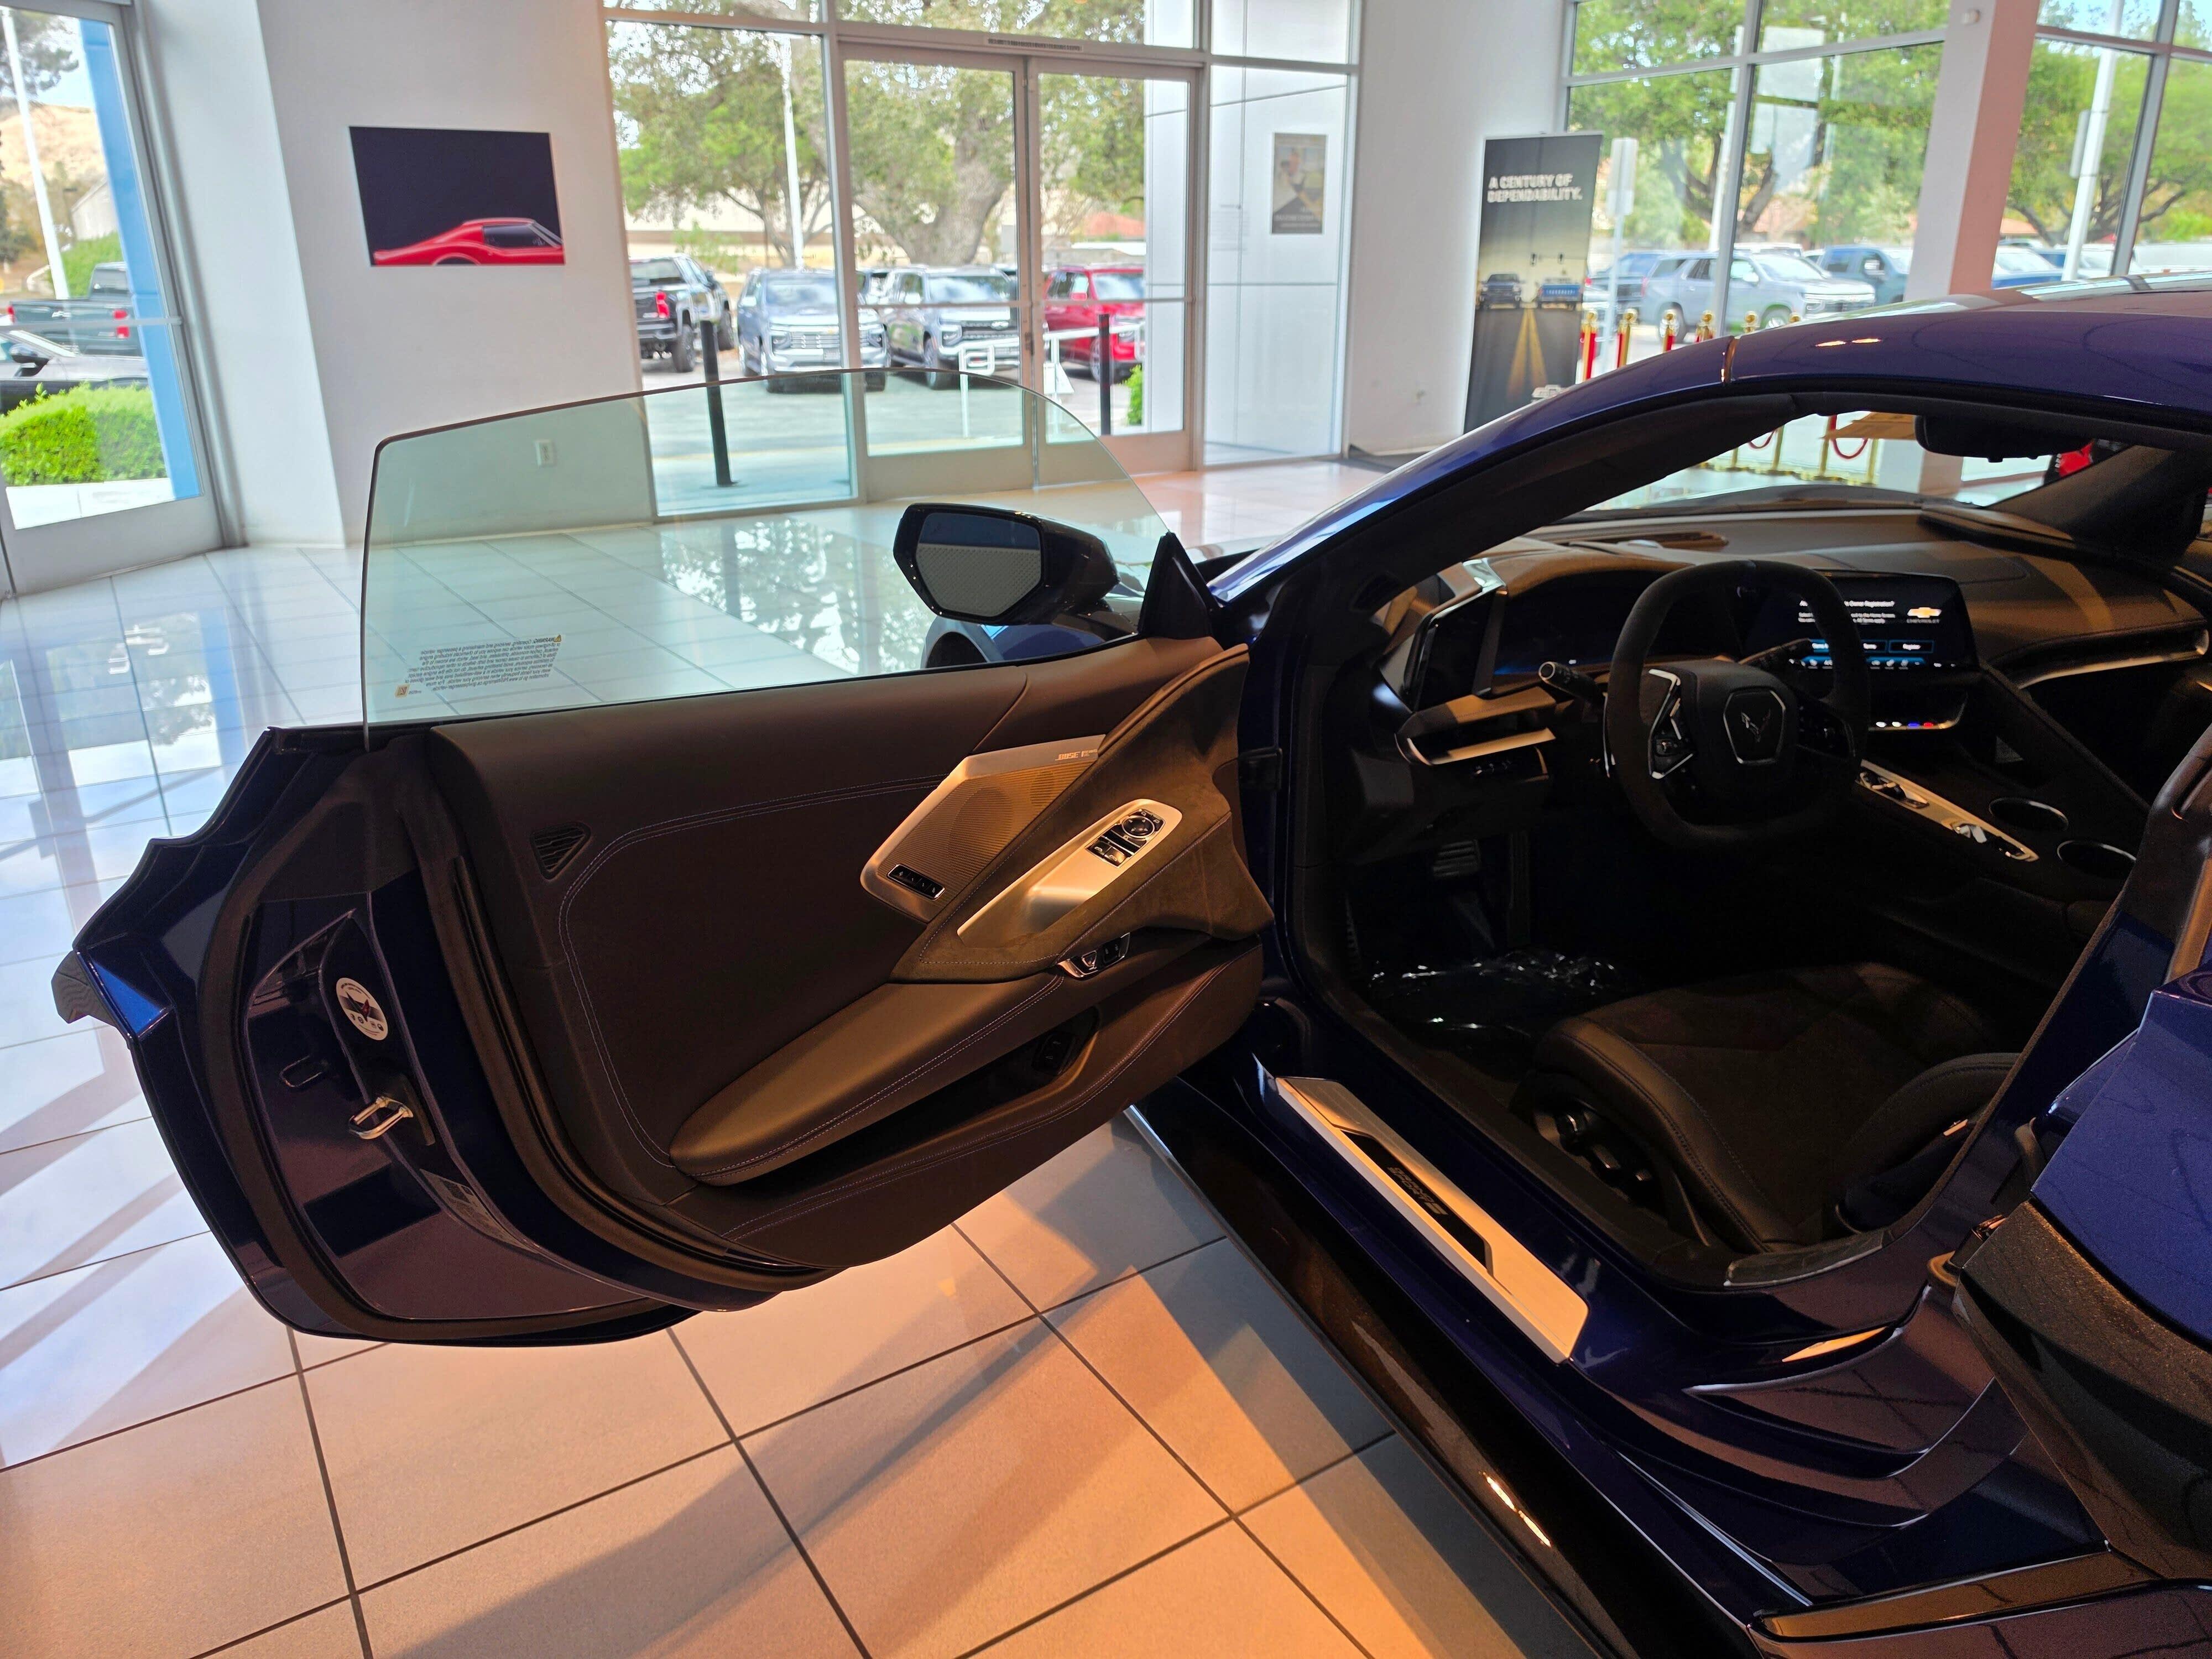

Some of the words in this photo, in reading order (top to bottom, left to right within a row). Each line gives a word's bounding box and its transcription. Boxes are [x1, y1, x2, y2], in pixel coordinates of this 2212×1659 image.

[1489, 177, 1498, 189] A
[1499, 175, 1554, 189] CENTURY
[1555, 173, 1573, 187] OF
